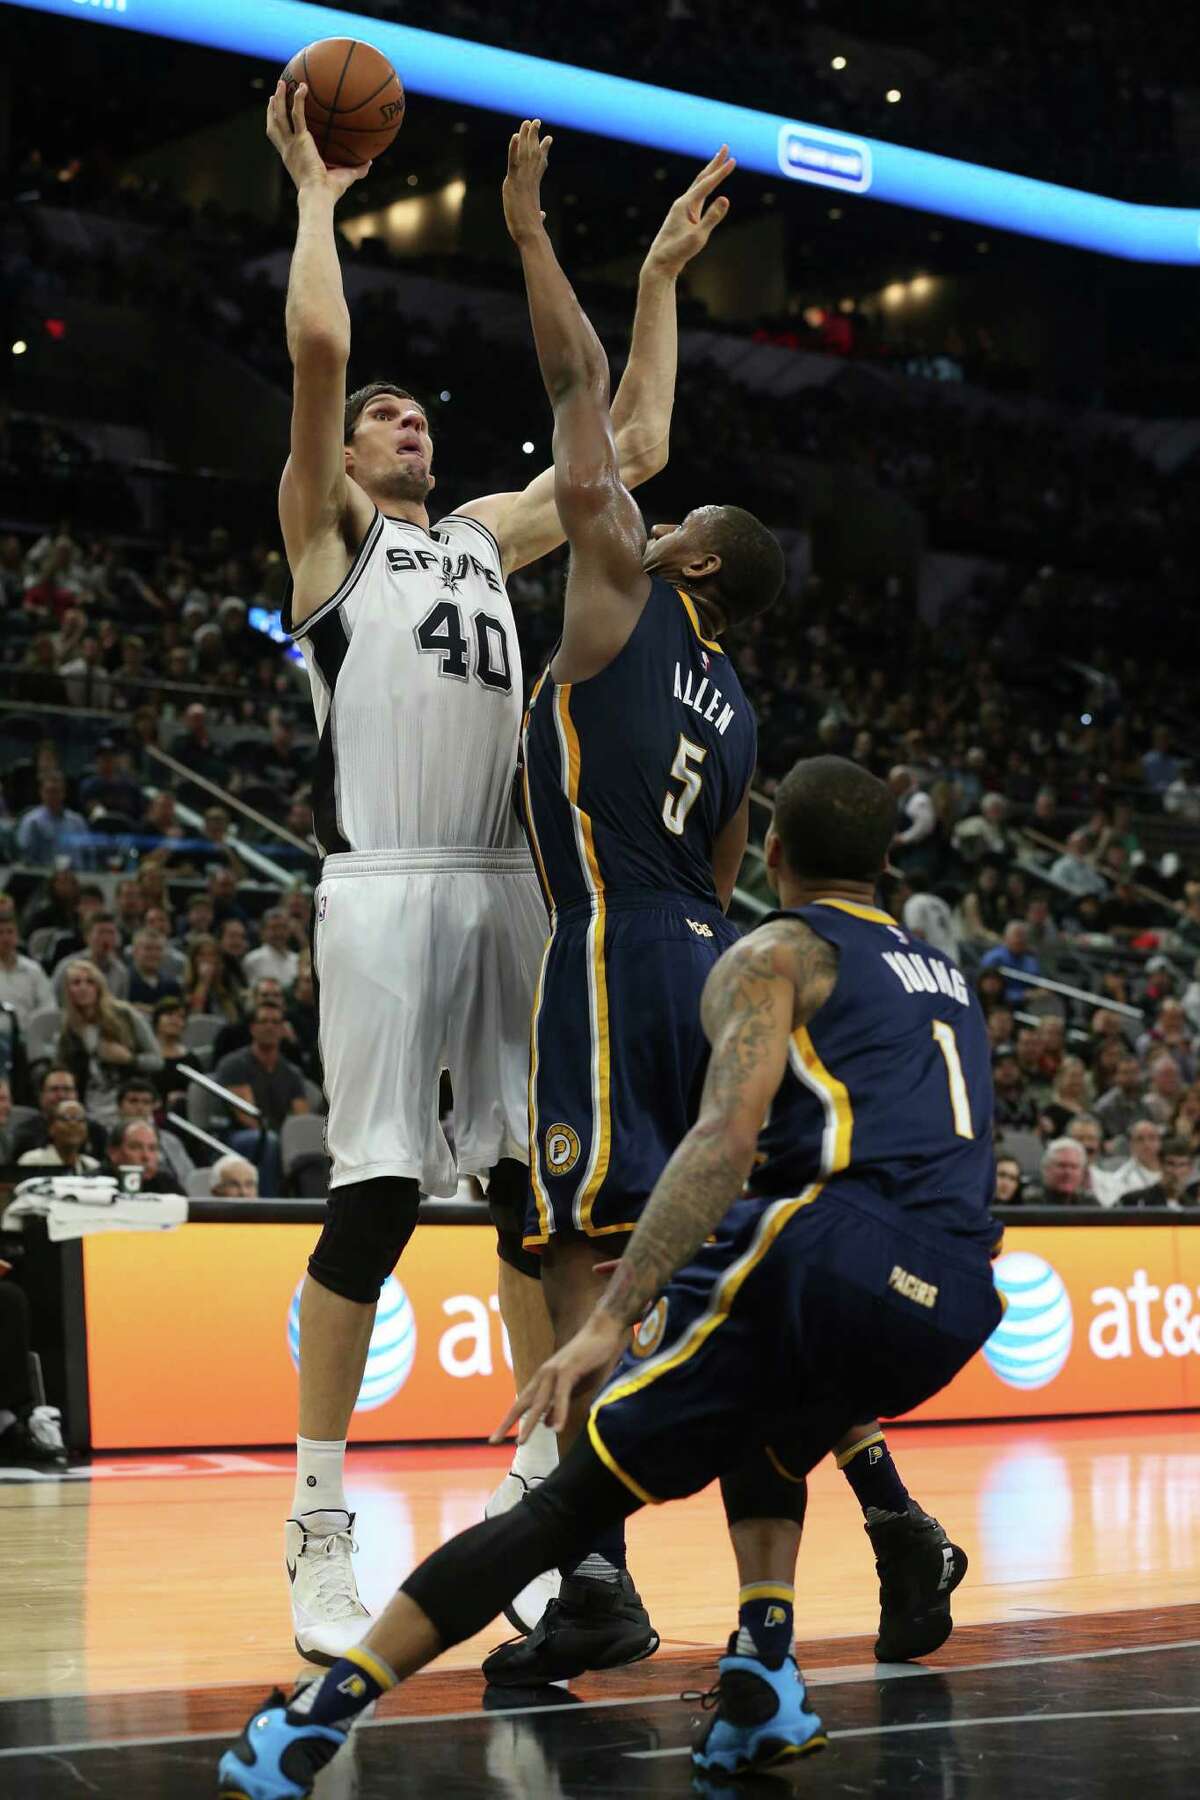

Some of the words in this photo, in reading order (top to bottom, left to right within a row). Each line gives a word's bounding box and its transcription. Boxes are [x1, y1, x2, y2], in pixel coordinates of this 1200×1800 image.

[386, 548, 502, 594] SPURS
[414, 599, 513, 696] 40
[673, 661, 735, 736] ALLEN
[662, 731, 708, 836] 5
[878, 951, 970, 1008] YOUNG
[932, 1018, 975, 1140] 1
[1089, 1268, 1200, 1360] at&
